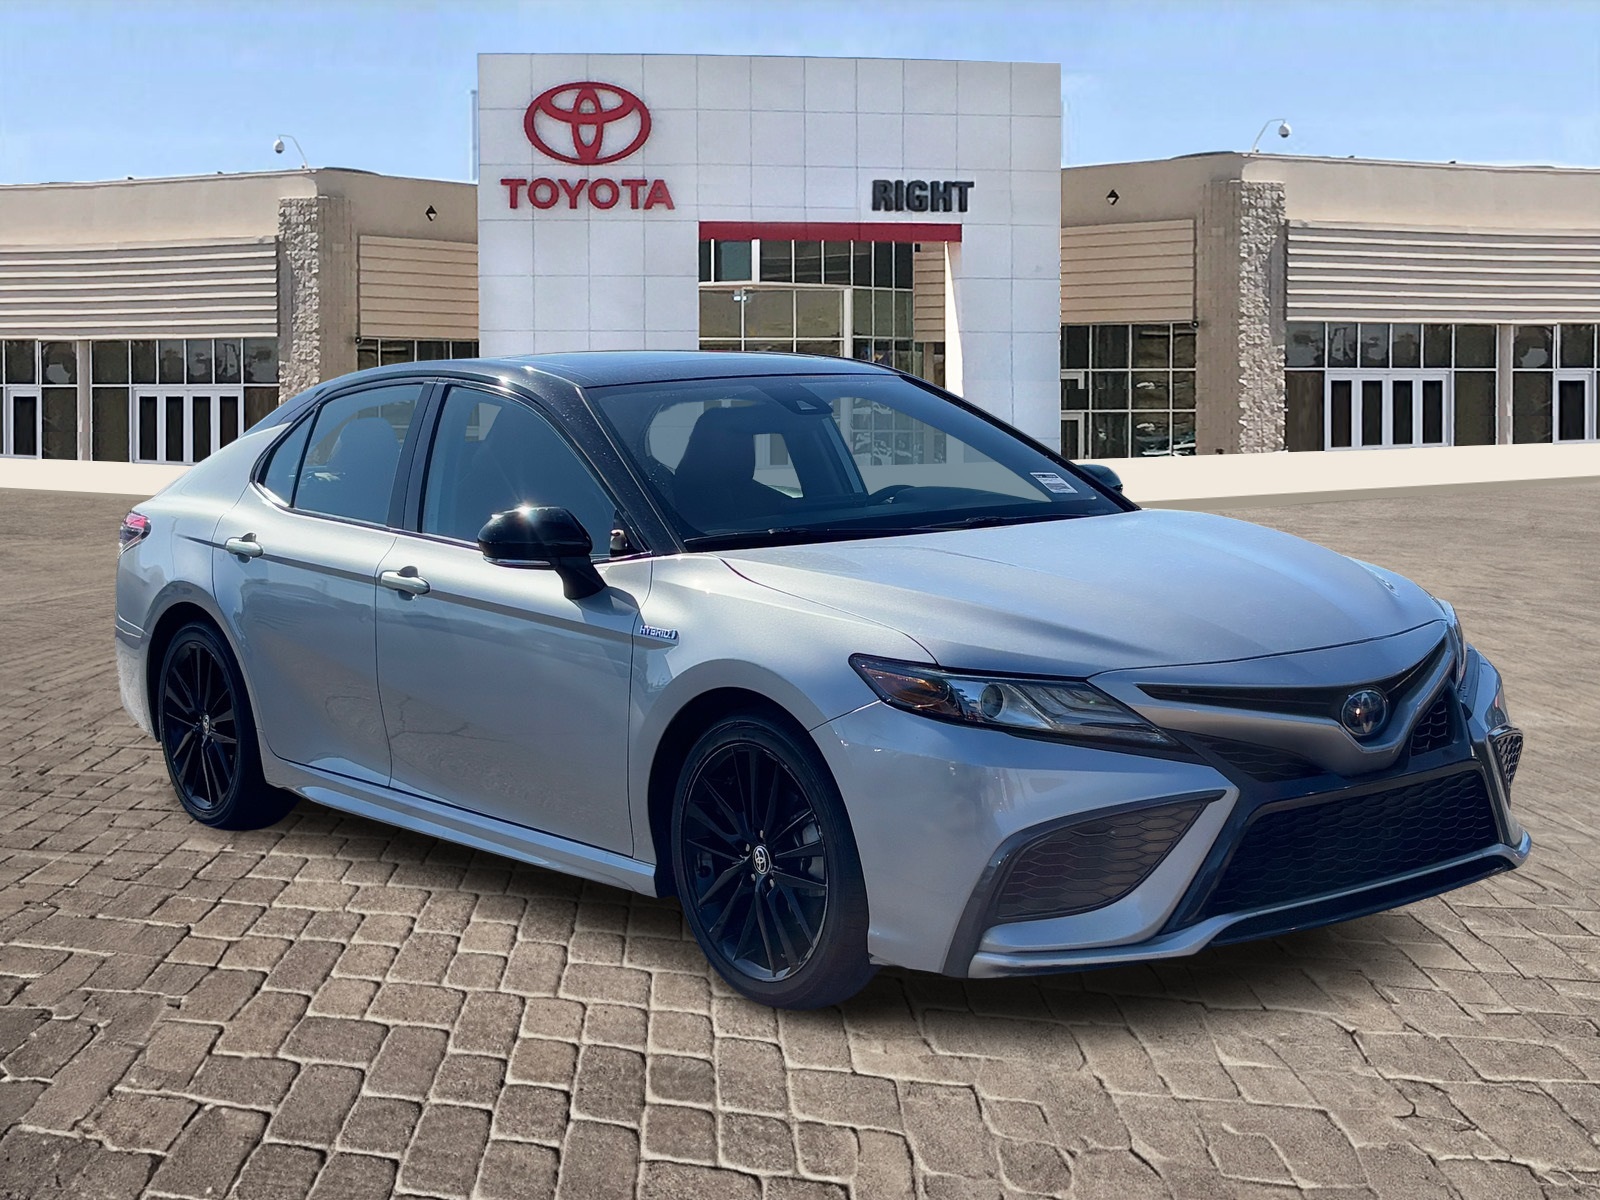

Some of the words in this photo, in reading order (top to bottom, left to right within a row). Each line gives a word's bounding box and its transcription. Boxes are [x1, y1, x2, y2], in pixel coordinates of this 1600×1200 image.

[500, 177, 675, 209] TOYOTA
[872, 180, 974, 212] RIGHT
[640, 625, 671, 638] HYBRID
